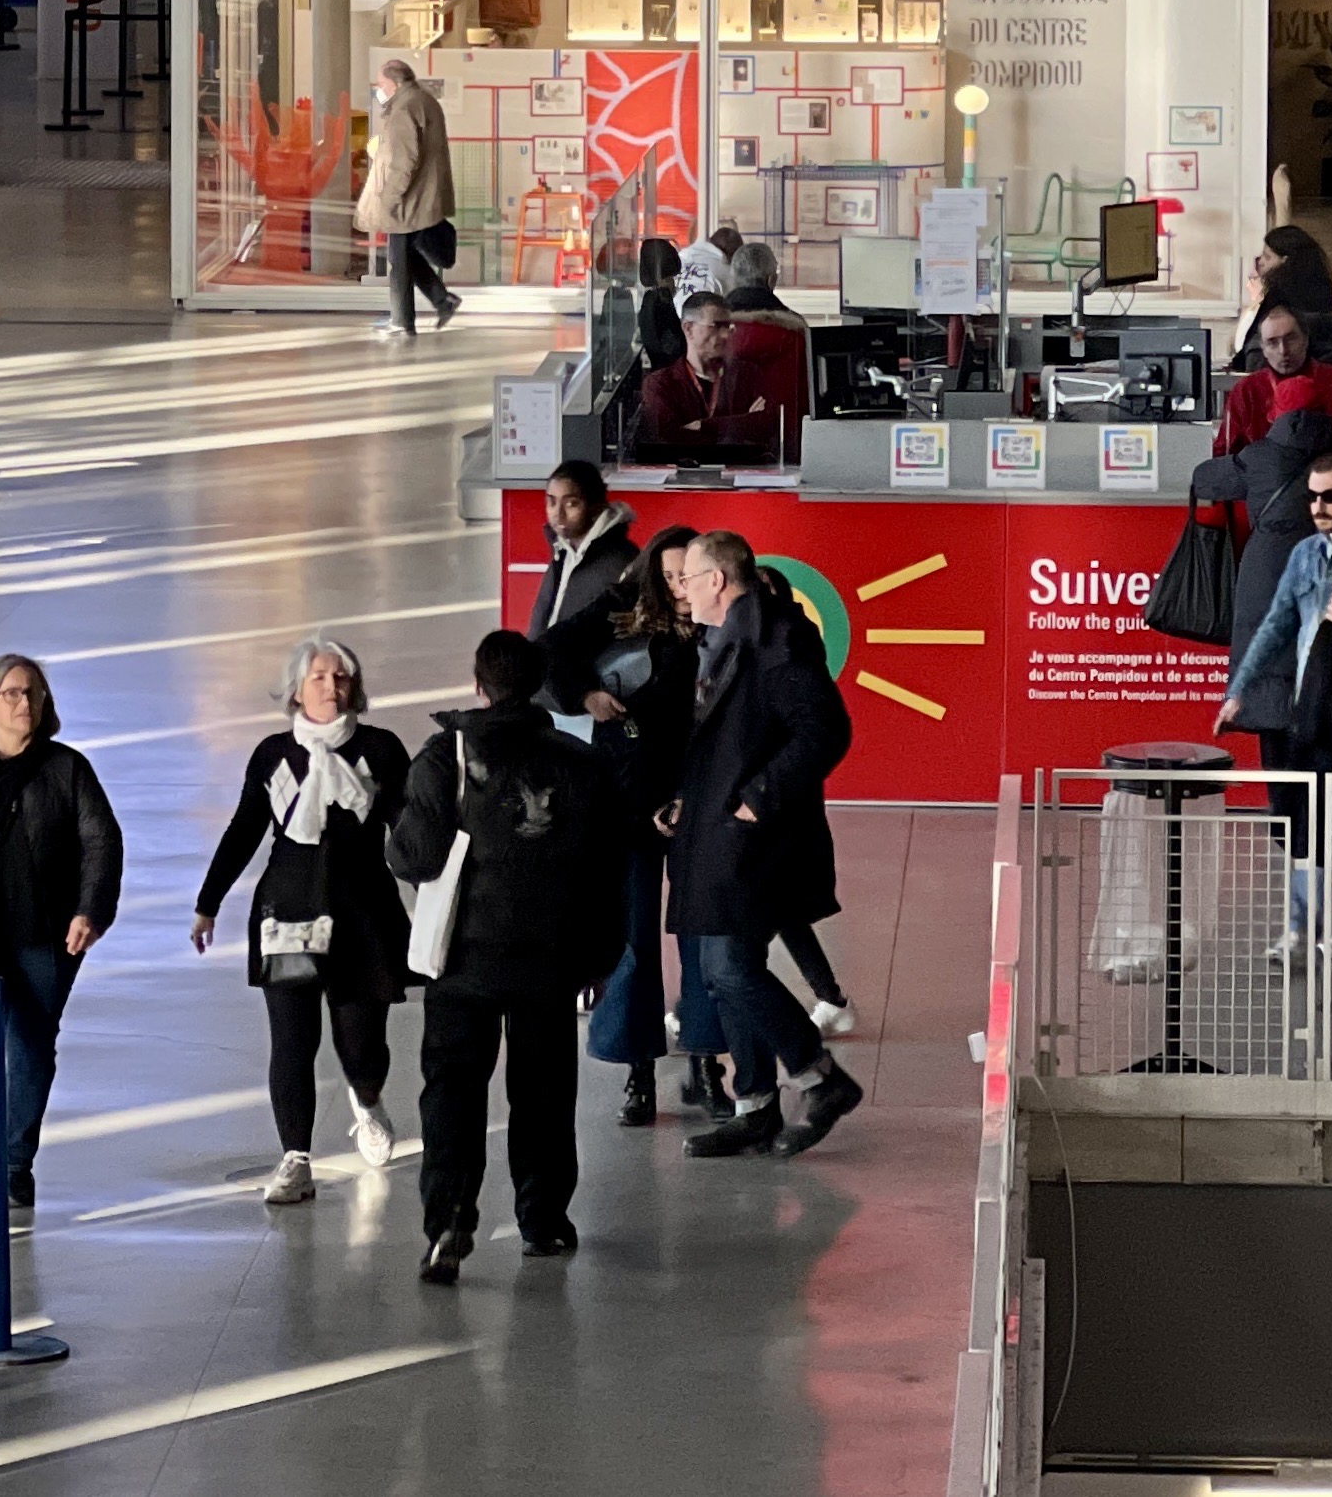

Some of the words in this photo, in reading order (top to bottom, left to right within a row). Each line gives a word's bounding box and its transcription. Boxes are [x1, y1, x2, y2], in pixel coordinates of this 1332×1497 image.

[969, 18, 998, 46] DU
[1005, 18, 1087, 46] CENTRE
[969, 60, 1083, 88] POMPIDOU
[1029, 558, 1160, 605] Suive
[1028, 612, 1081, 630] Follow
[1085, 612, 1111, 630] the
[1028, 651, 1044, 664] Je
[1047, 654, 1075, 664] vous
[1078, 653, 1152, 667] accompagne
[1166, 652, 1177, 665] la
[1181, 652, 1229, 665] découve
[1028, 668, 1044, 681] du
[1047, 668, 1086, 681] Centre
[1090, 668, 1148, 684] Pompidou
[1151, 670, 1163, 682] et
[1167, 669, 1181, 682] de
[1185, 672, 1204, 683] ses
[1028, 689, 1067, 700] Discover
[1070, 689, 1085, 700] the
[1087, 689, 1119, 701] Centre
[1121, 689, 1166, 703] Pompidou
[1169, 690, 1187, 701] and
[1189, 690, 1201, 701] its
